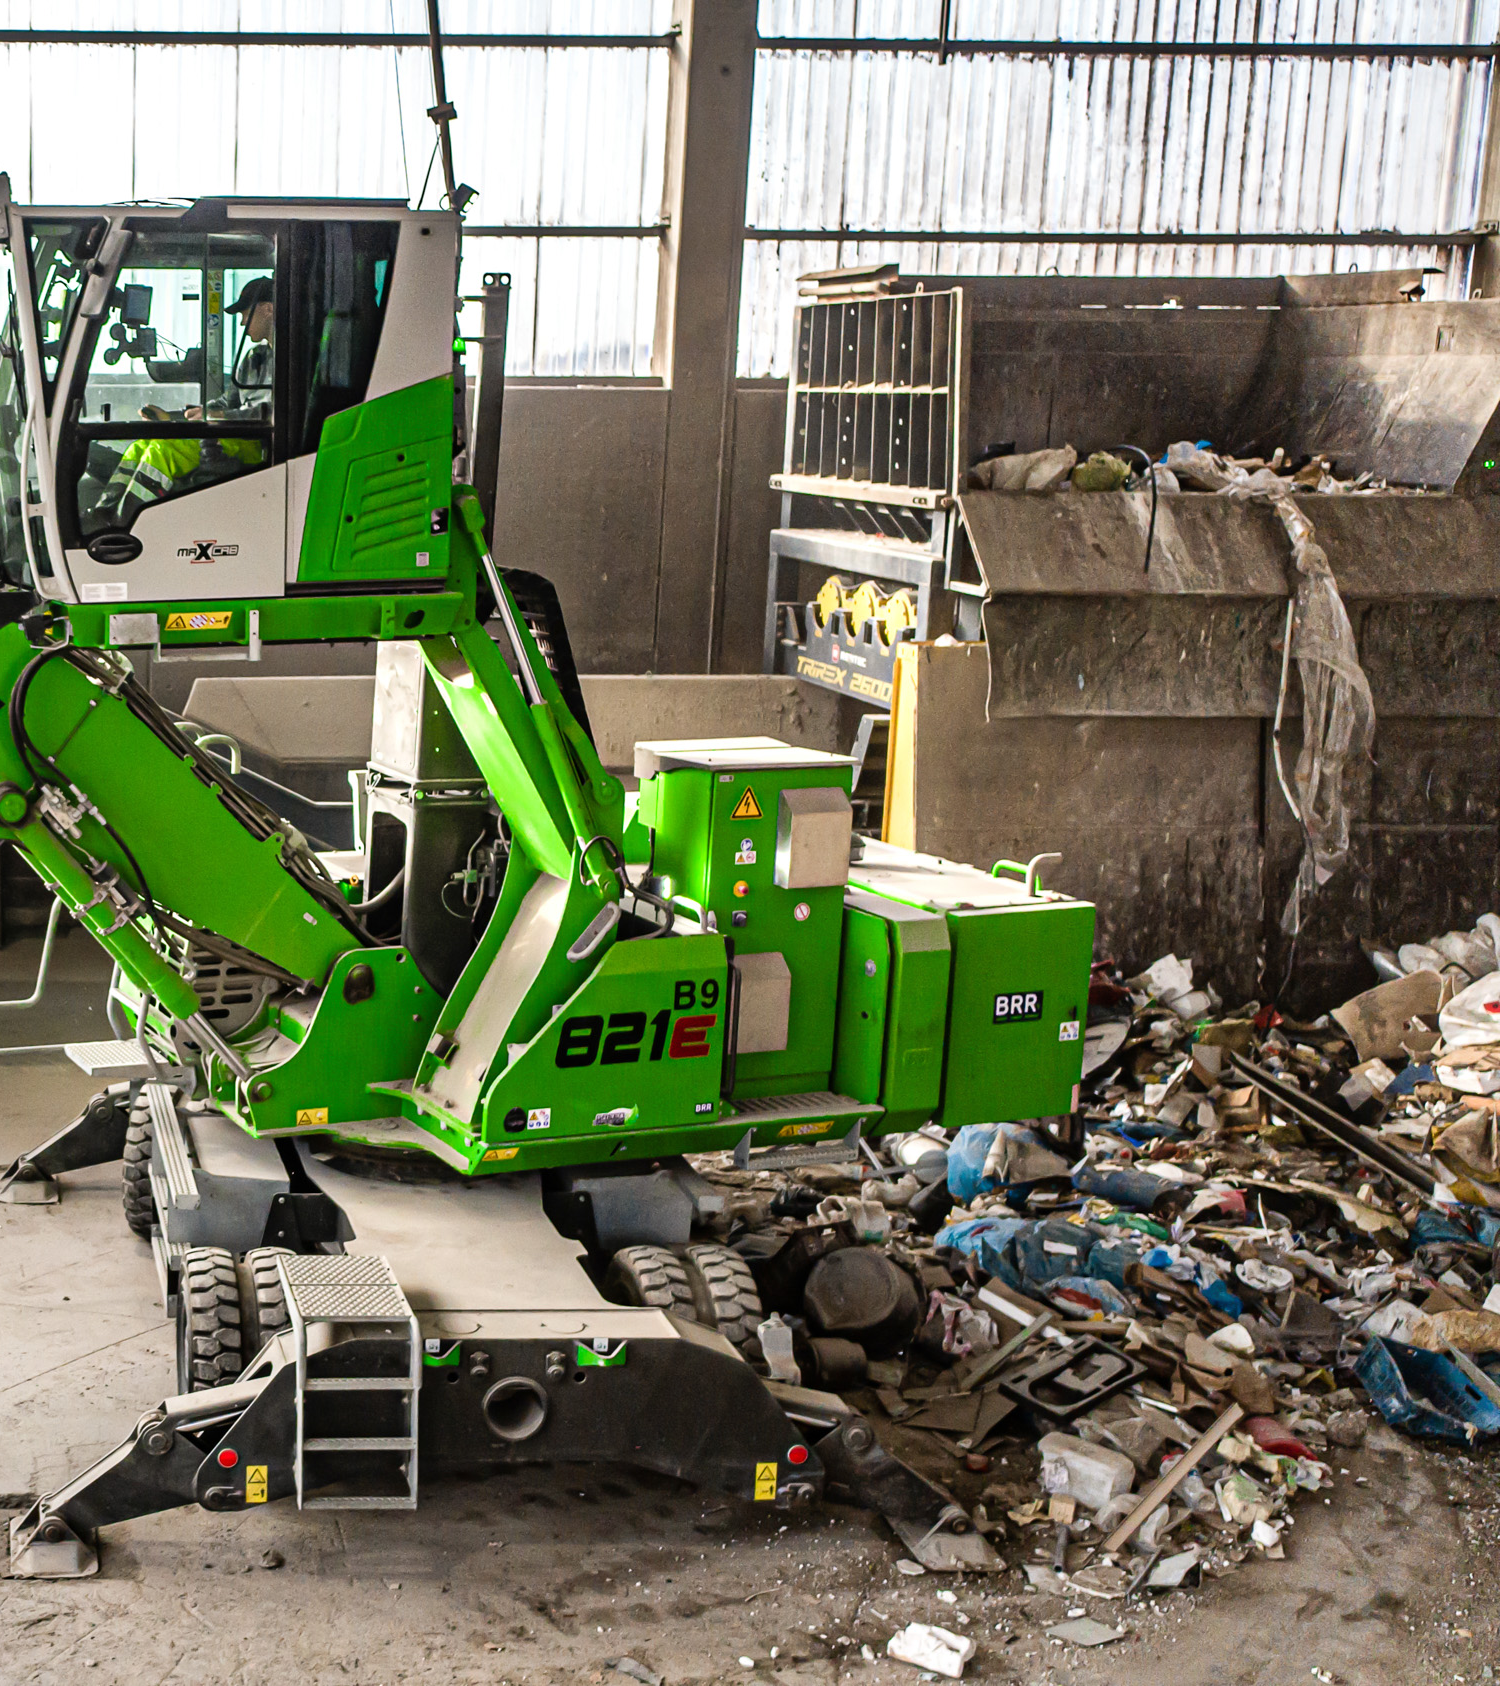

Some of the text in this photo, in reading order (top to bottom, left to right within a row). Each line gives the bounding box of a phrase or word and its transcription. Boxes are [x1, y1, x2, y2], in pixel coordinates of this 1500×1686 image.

[797, 655, 893, 703] TRIREX 2600
[674, 979, 719, 1010] B9
[995, 993, 1038, 1016] BRR
[555, 1009, 717, 1068] 821E
[695, 1103, 712, 1113] BRR
